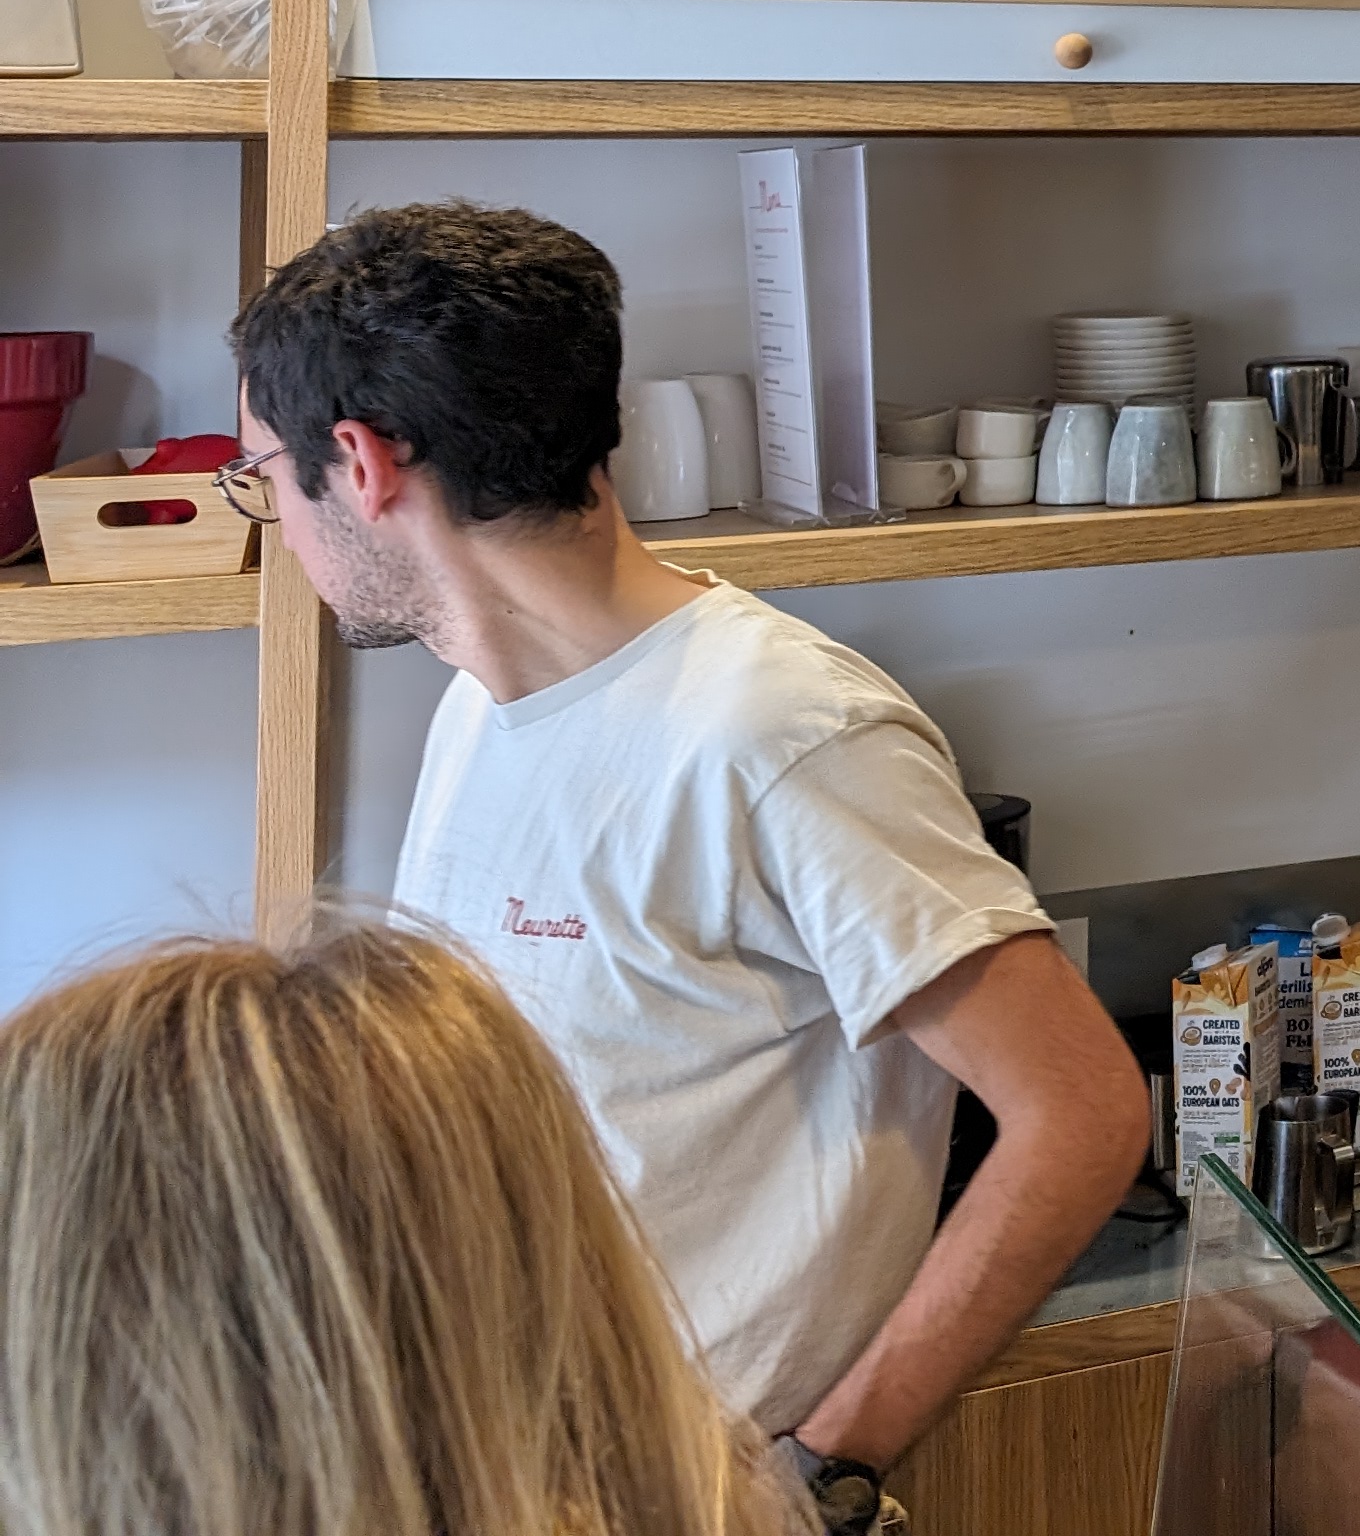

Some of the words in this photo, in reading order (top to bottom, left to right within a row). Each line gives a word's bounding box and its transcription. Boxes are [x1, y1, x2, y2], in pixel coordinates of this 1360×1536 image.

[1203, 1019, 1240, 1030] CREATED
[1203, 1035, 1241, 1046] BARISTAS
[1324, 1057, 1350, 1069] 100%
[1182, 1085, 1207, 1096] 100%
[1182, 1097, 1220, 1107] EUROPEAN
[1222, 1097, 1240, 1107] OATS
